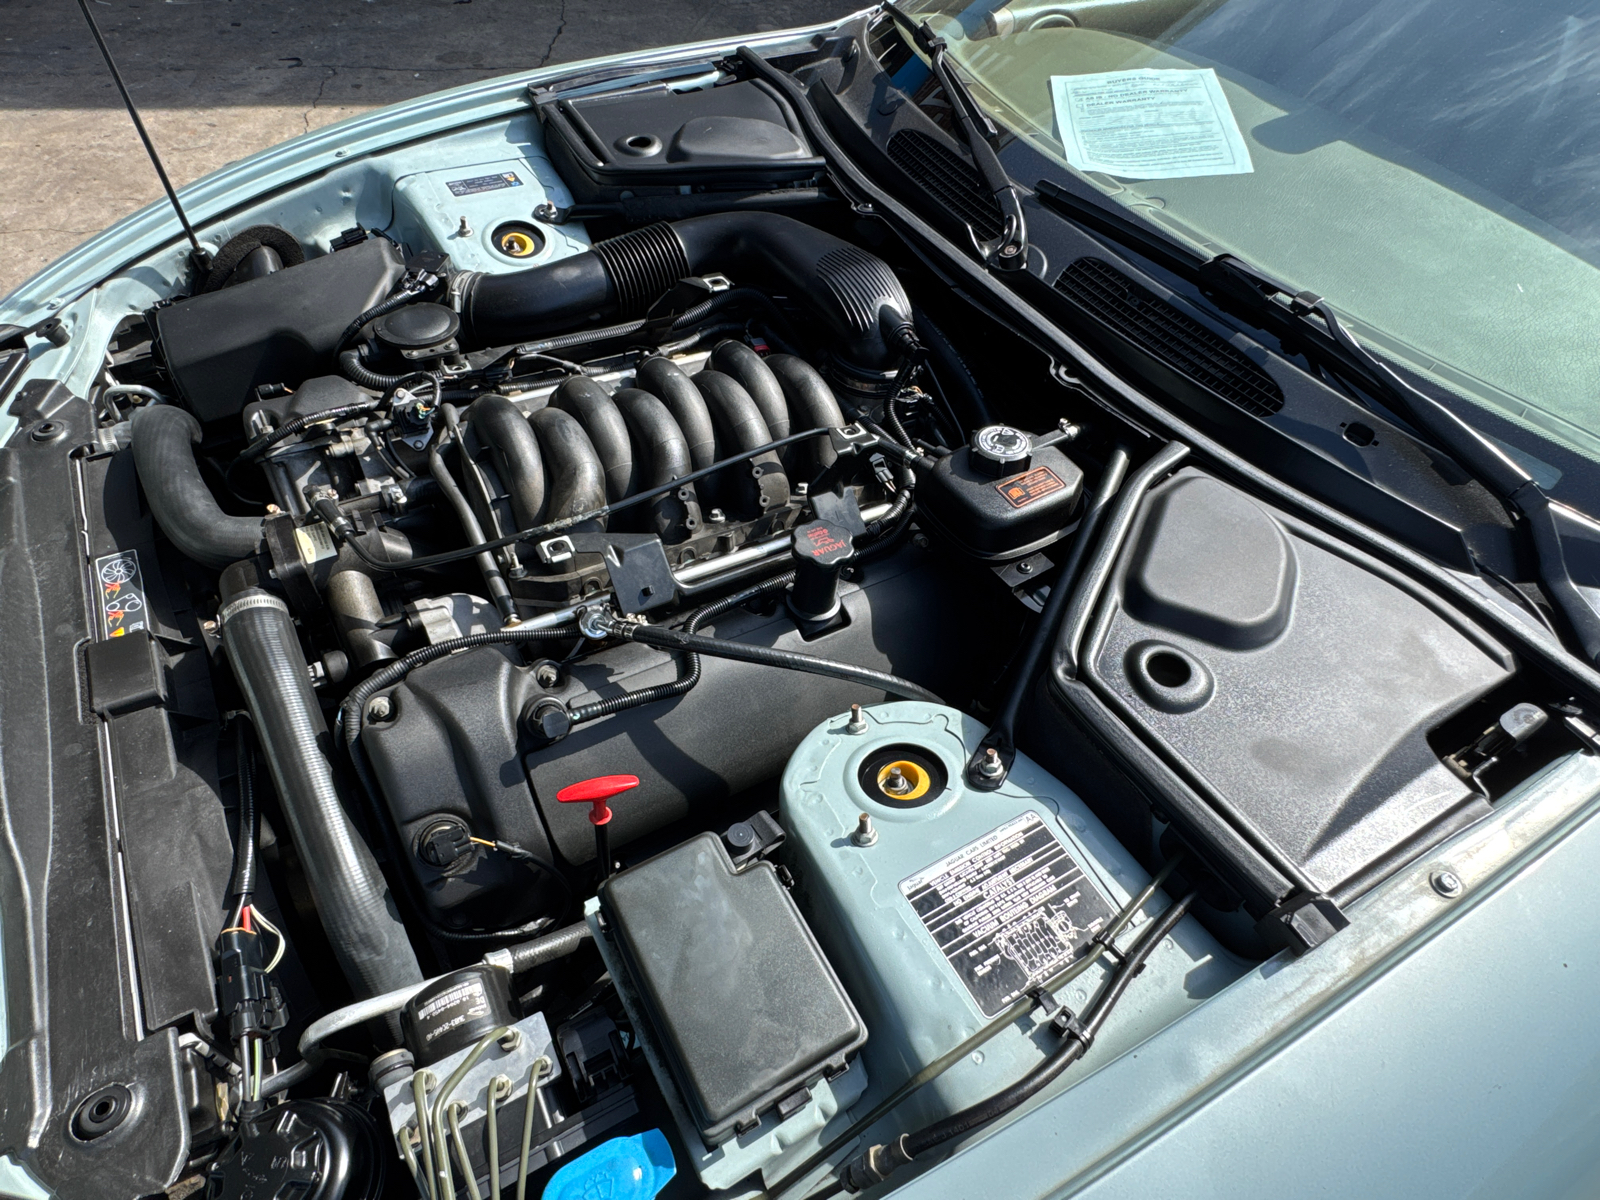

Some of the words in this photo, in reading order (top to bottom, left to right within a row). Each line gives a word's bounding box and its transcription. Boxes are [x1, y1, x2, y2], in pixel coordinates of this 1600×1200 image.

[811, 540, 846, 556] JAGUAR
[1024, 813, 1036, 822] AA
[944, 853, 964, 867] JAGUAR
[965, 844, 980, 855] CARS
[979, 834, 998, 847] LIMITED
[929, 873, 949, 886] VEHICLE
[971, 848, 993, 863] CONTROL
[982, 876, 1015, 899] CATALYST
[972, 919, 999, 938] VACUUM
[1028, 884, 1057, 904] DIAGRAM
